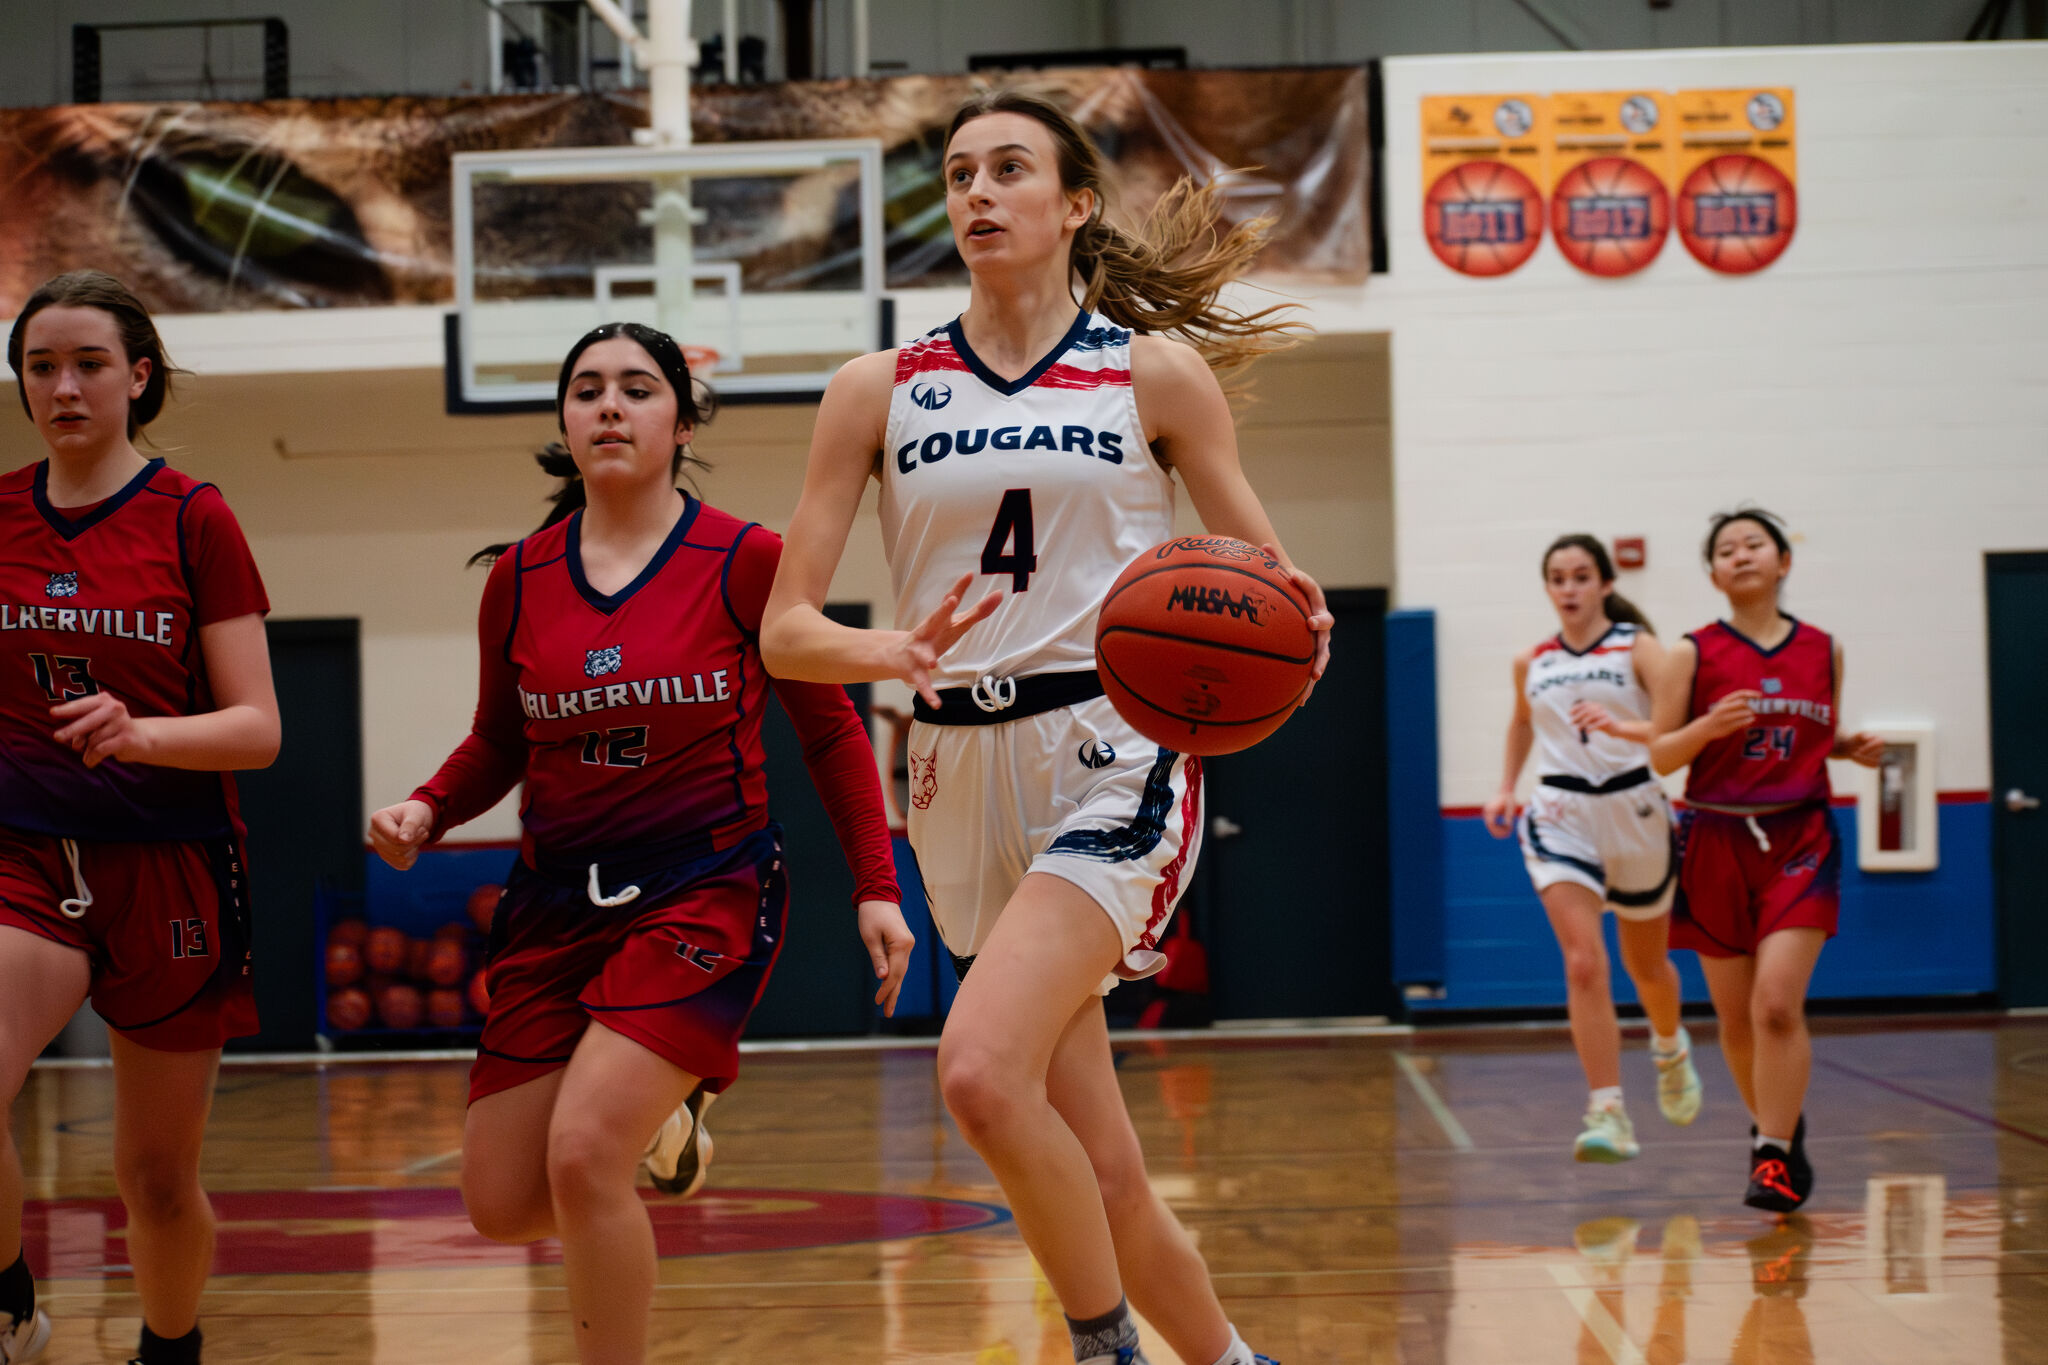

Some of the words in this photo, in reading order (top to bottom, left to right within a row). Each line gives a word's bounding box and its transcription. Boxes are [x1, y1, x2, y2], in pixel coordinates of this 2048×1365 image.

[897, 425, 1124, 475] COUGARS
[980, 488, 1038, 594] 4
[28, 653, 100, 701] 13
[578, 725, 650, 768] 12
[1743, 726, 1796, 760] 24
[169, 918, 209, 959] 13
